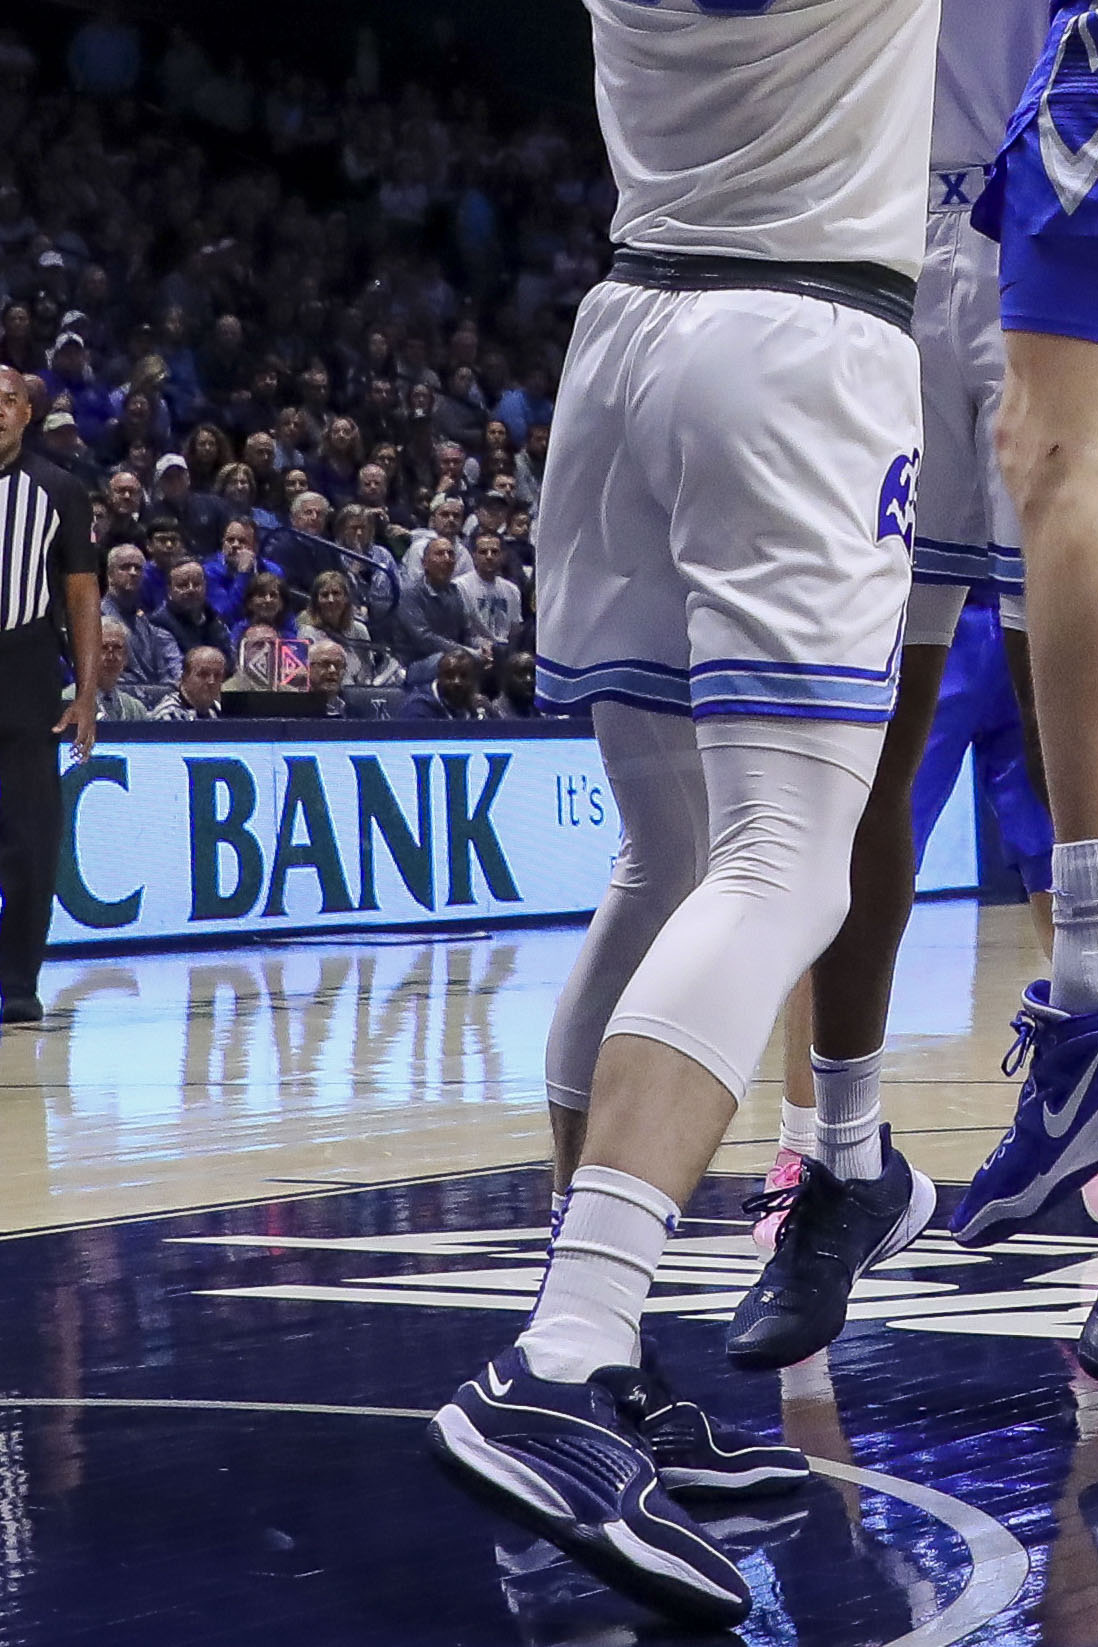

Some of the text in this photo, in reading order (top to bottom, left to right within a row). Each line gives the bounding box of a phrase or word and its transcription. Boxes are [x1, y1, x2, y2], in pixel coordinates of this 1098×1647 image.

[937, 173, 970, 205] X
[182, 753, 524, 922] BANK
[556, 774, 604, 827] It's
